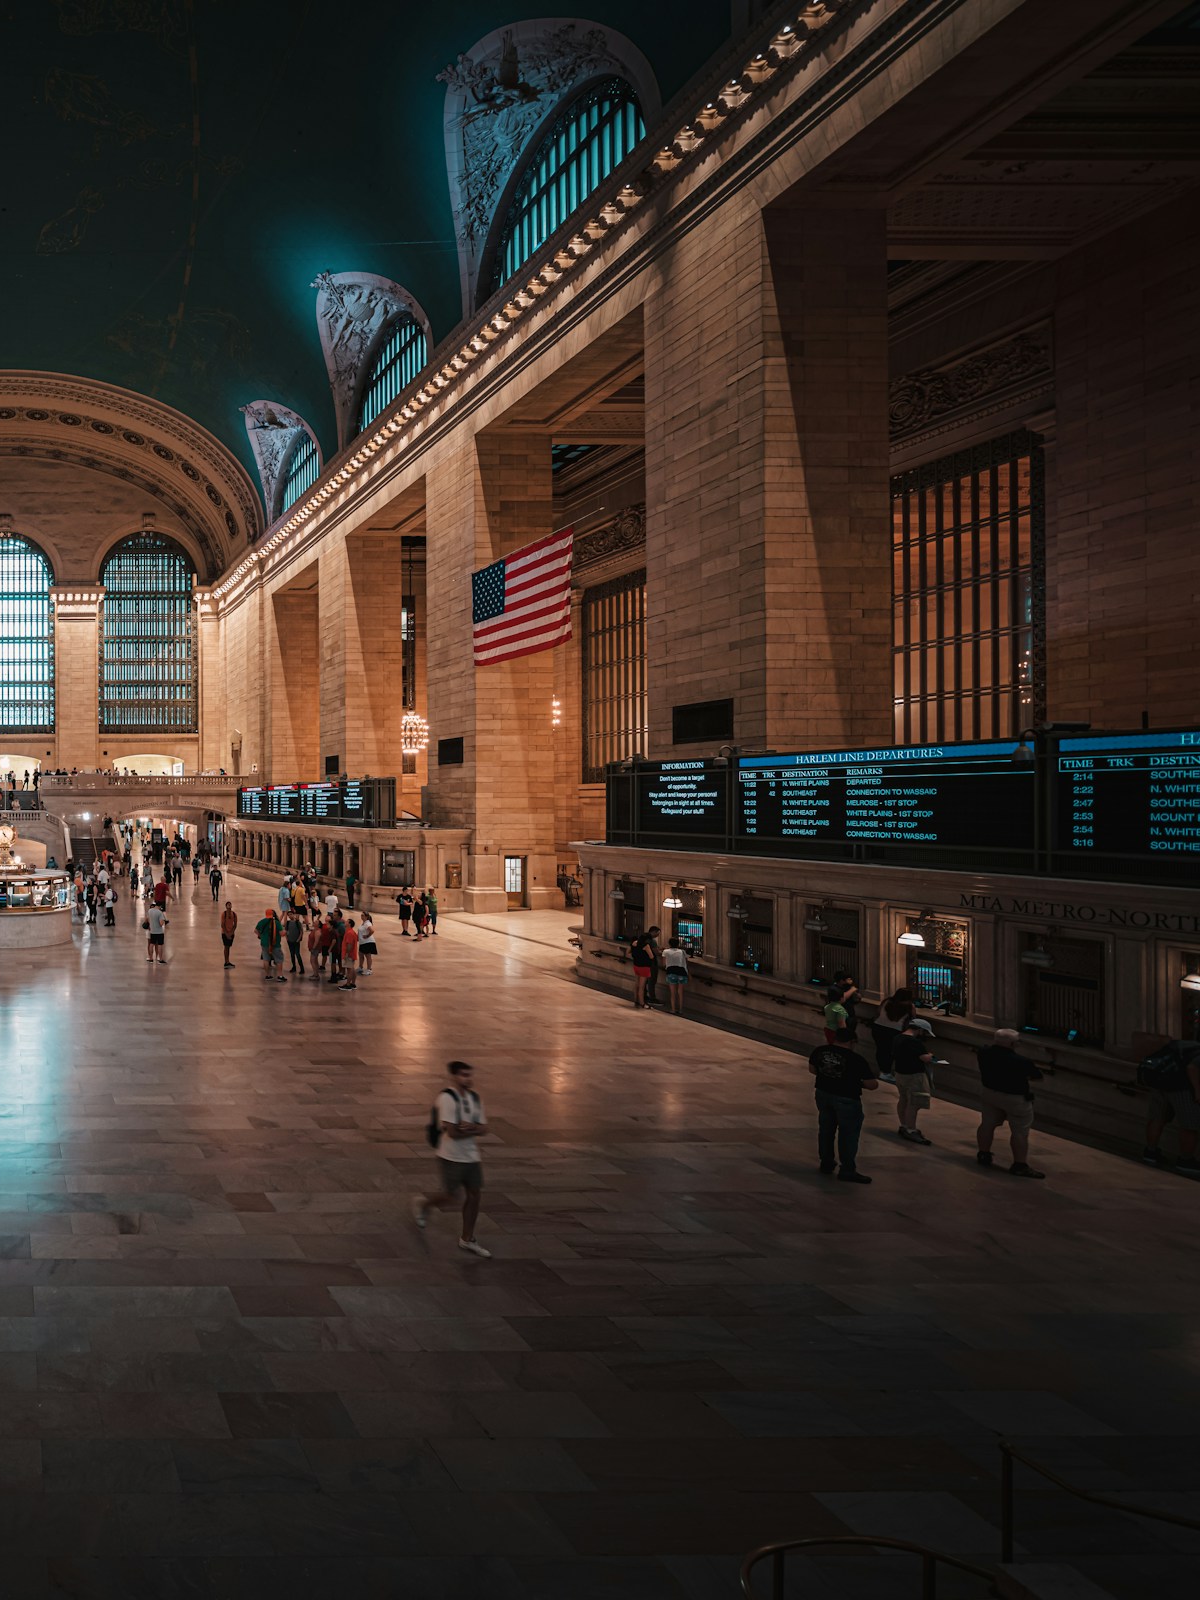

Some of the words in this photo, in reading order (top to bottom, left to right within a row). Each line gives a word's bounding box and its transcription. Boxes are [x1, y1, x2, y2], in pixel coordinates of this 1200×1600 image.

[796, 754, 837, 764] HARLEM
[839, 753, 864, 762] LINE
[866, 748, 943, 761] DEPARTURES
[661, 761, 704, 770] INFORMATION
[1063, 760, 1094, 768] TIME
[1107, 758, 1134, 767] TRK
[781, 769, 828, 777] DESTINATION
[846, 767, 883, 775] REMARKS
[1073, 773, 1094, 781] 2:14
[782, 789, 817, 797] SOUTHEAST
[846, 788, 891, 796] CONNECTION
[1073, 786, 1094, 794] 2:22
[1150, 785, 1162, 793] N.
[1073, 799, 1094, 807] 2:47
[1073, 812, 1094, 820] 2:53
[1150, 813, 1195, 822] MOUNT
[782, 828, 817, 836] SOUTHEAST
[846, 830, 891, 838] CONNECTION
[903, 832, 937, 840] WASSAIC
[1073, 825, 1094, 833] 2:54
[1150, 827, 1162, 836] N.
[960, 894, 1004, 911] MTA
